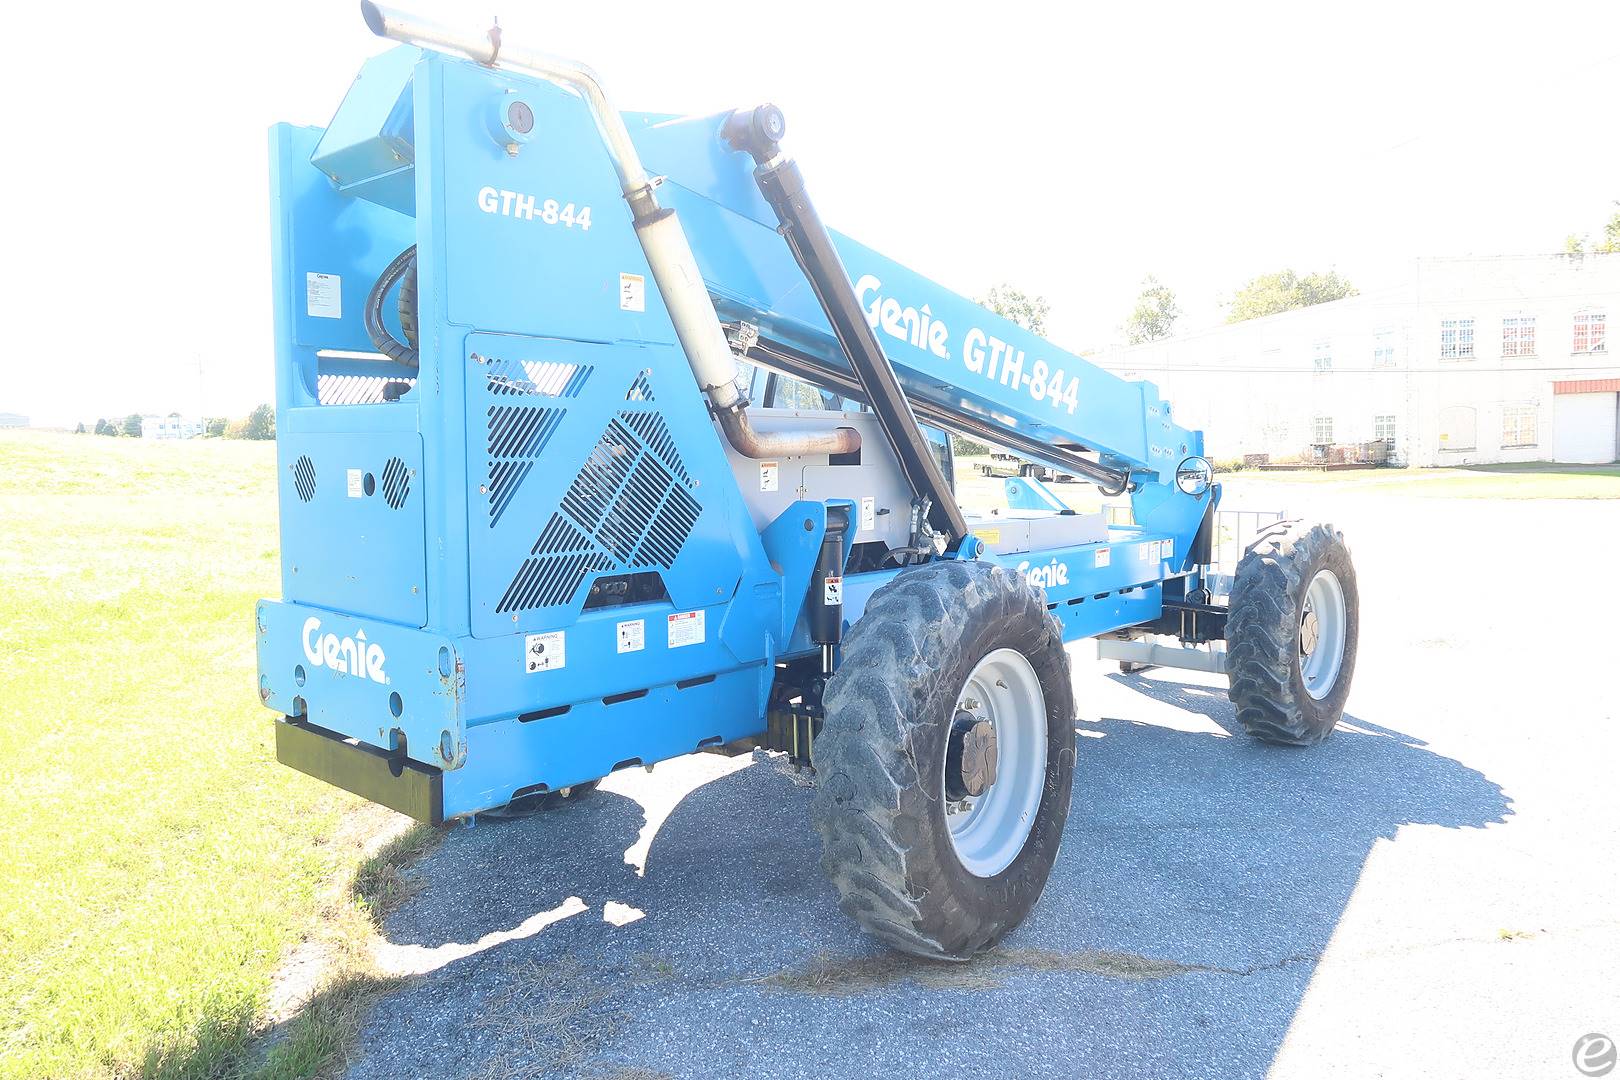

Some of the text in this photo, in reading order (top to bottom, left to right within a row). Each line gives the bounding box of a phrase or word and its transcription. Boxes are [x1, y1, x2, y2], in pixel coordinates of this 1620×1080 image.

[478, 186, 592, 231] GTH-844
[855, 274, 1080, 415] Genie GTH-844
[302, 616, 390, 685] Genie
